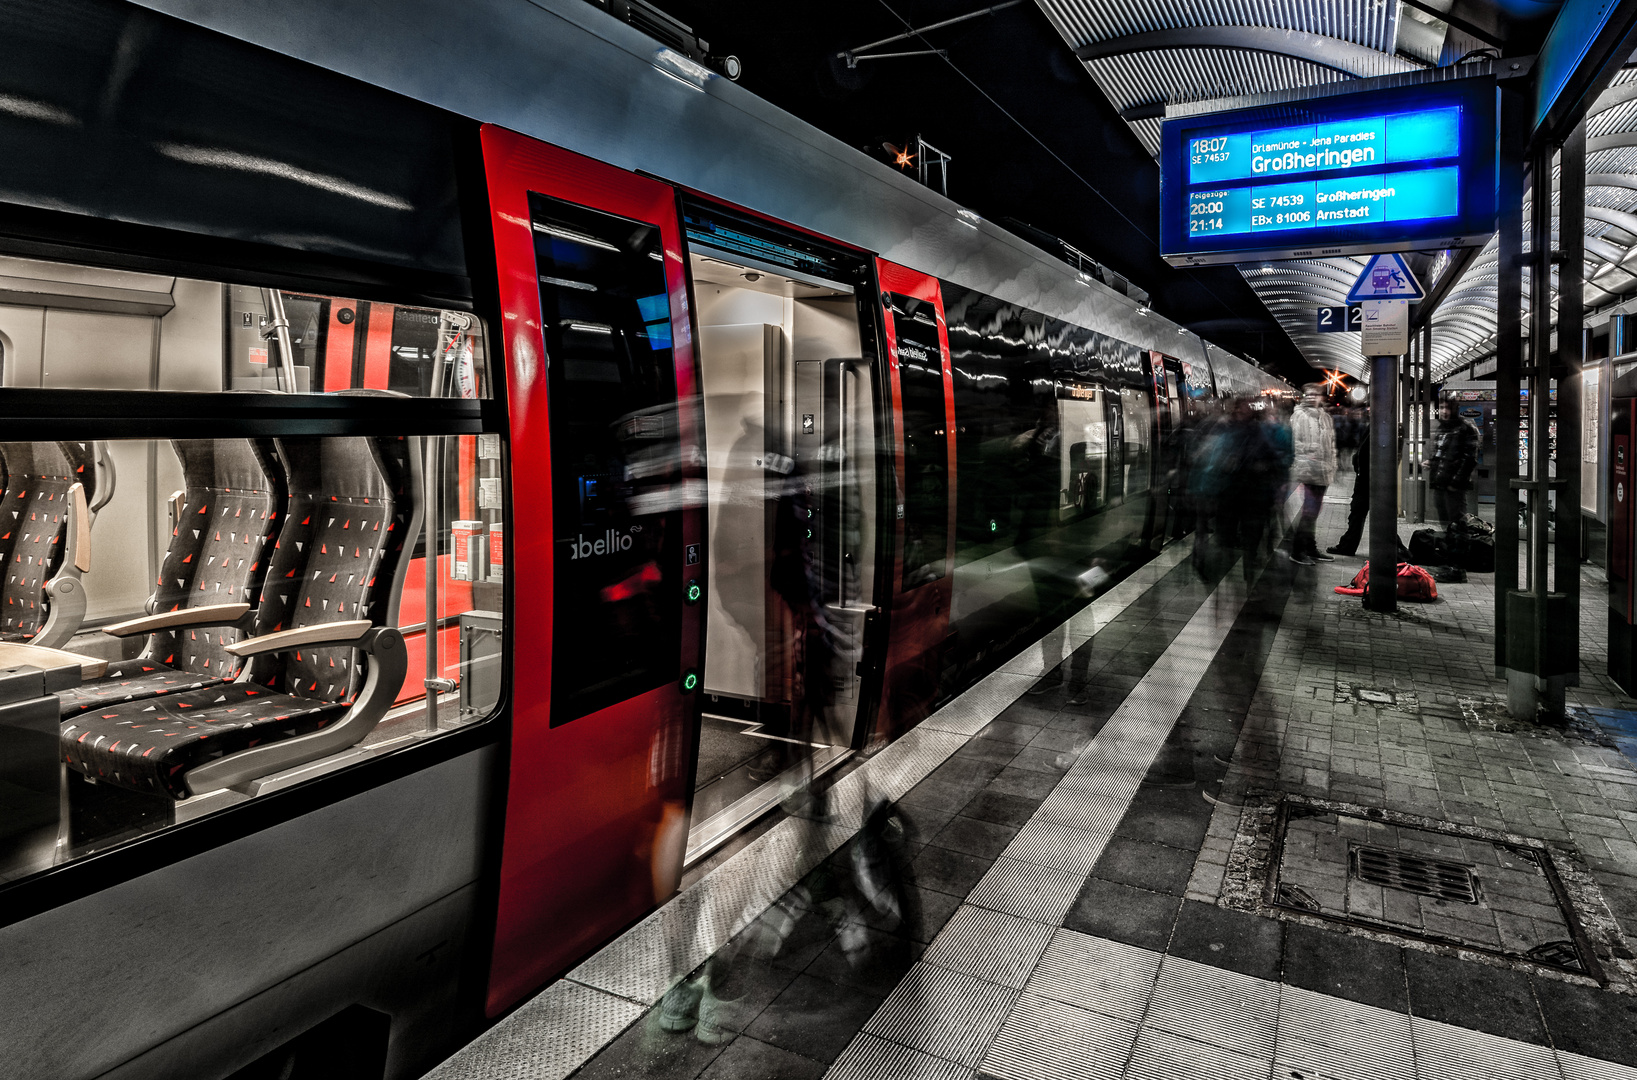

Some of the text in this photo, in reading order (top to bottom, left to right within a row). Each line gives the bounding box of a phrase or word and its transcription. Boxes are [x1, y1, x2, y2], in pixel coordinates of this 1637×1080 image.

[1193, 137, 1227, 153] 18:07
[1252, 140, 1300, 153] Orlamünde
[1310, 137, 1332, 147] Jena
[1334, 131, 1375, 143] Paradies
[1192, 152, 1230, 164] SE 74537
[1252, 147, 1375, 172] Großheringen
[1252, 187, 1395, 209] SE 74539 Großheringen
[1190, 202, 1223, 215] 20:00
[1252, 205, 1369, 226] EBx 81006 Arnstadt
[1190, 218, 1223, 231] 21:14
[1321, 308, 1333, 325] 2
[1351, 307, 1362, 324] 2
